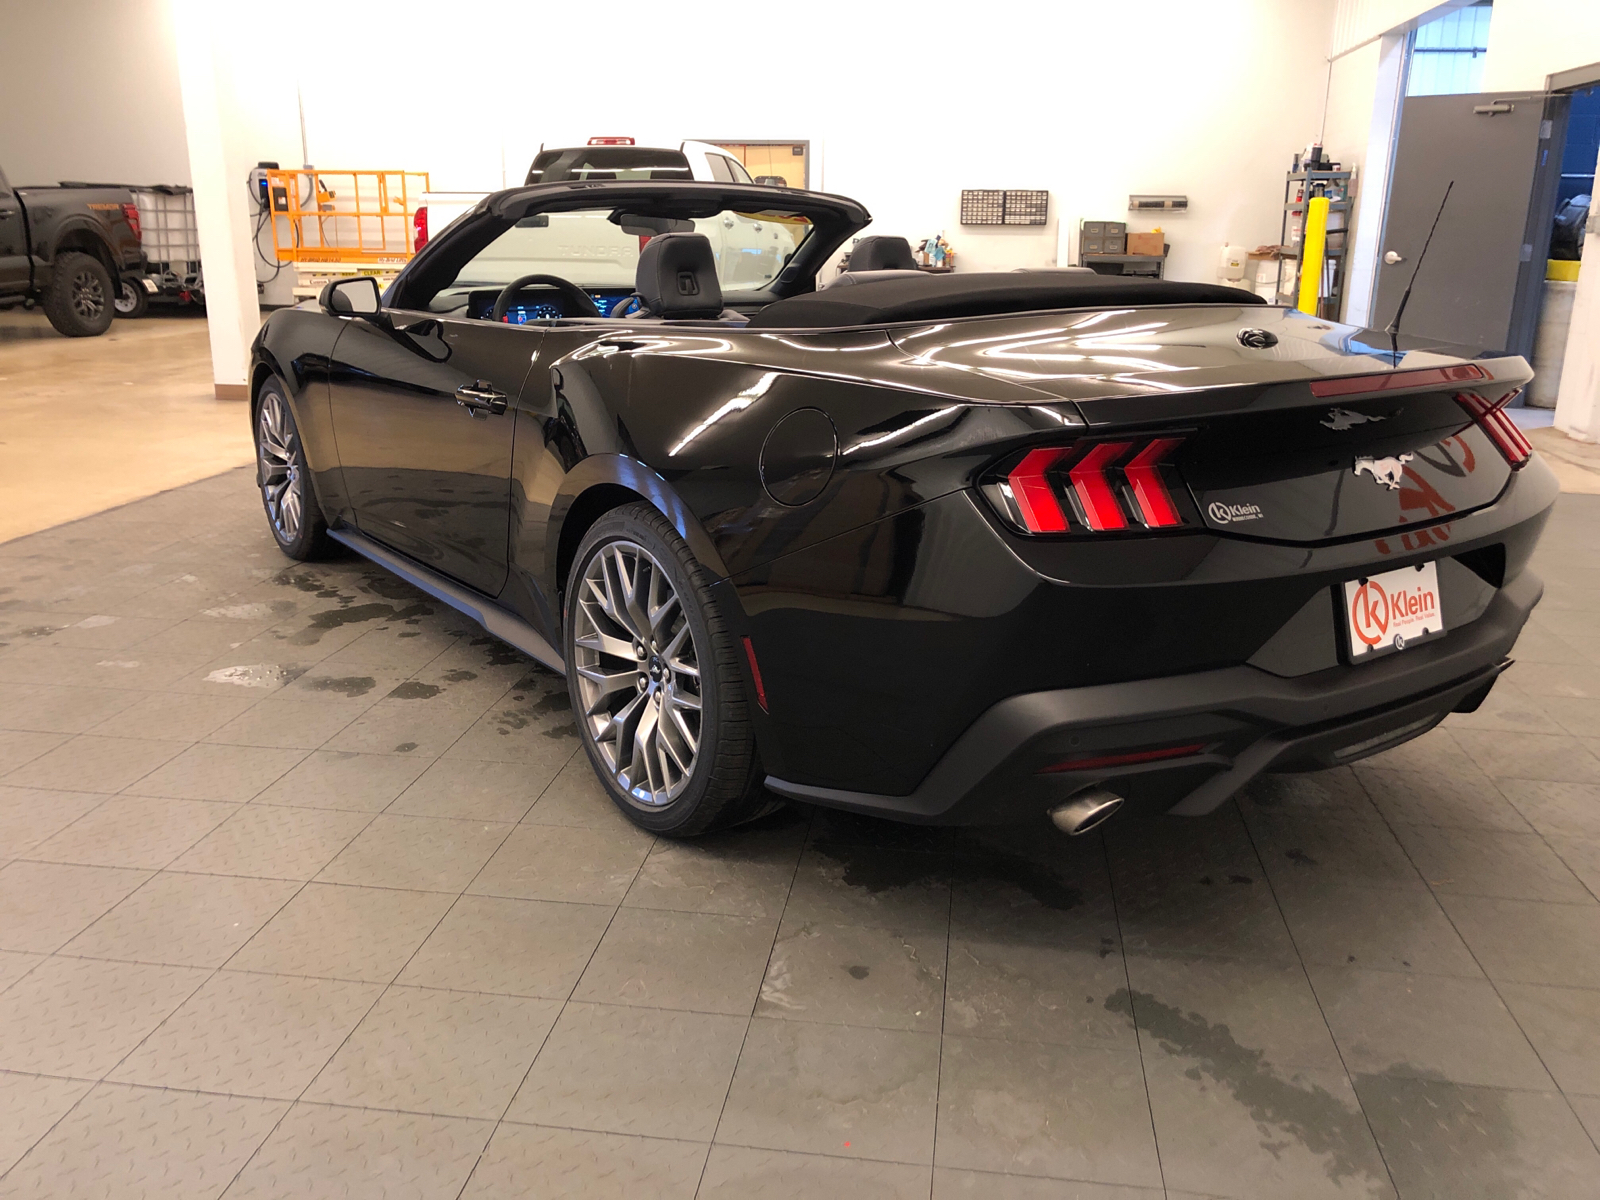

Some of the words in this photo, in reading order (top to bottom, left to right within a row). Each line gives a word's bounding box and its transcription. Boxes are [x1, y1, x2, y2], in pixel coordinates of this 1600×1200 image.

[558, 245, 634, 257] TUNDRA
[1229, 503, 1261, 516] Klein
[1390, 587, 1435, 620] Klein
